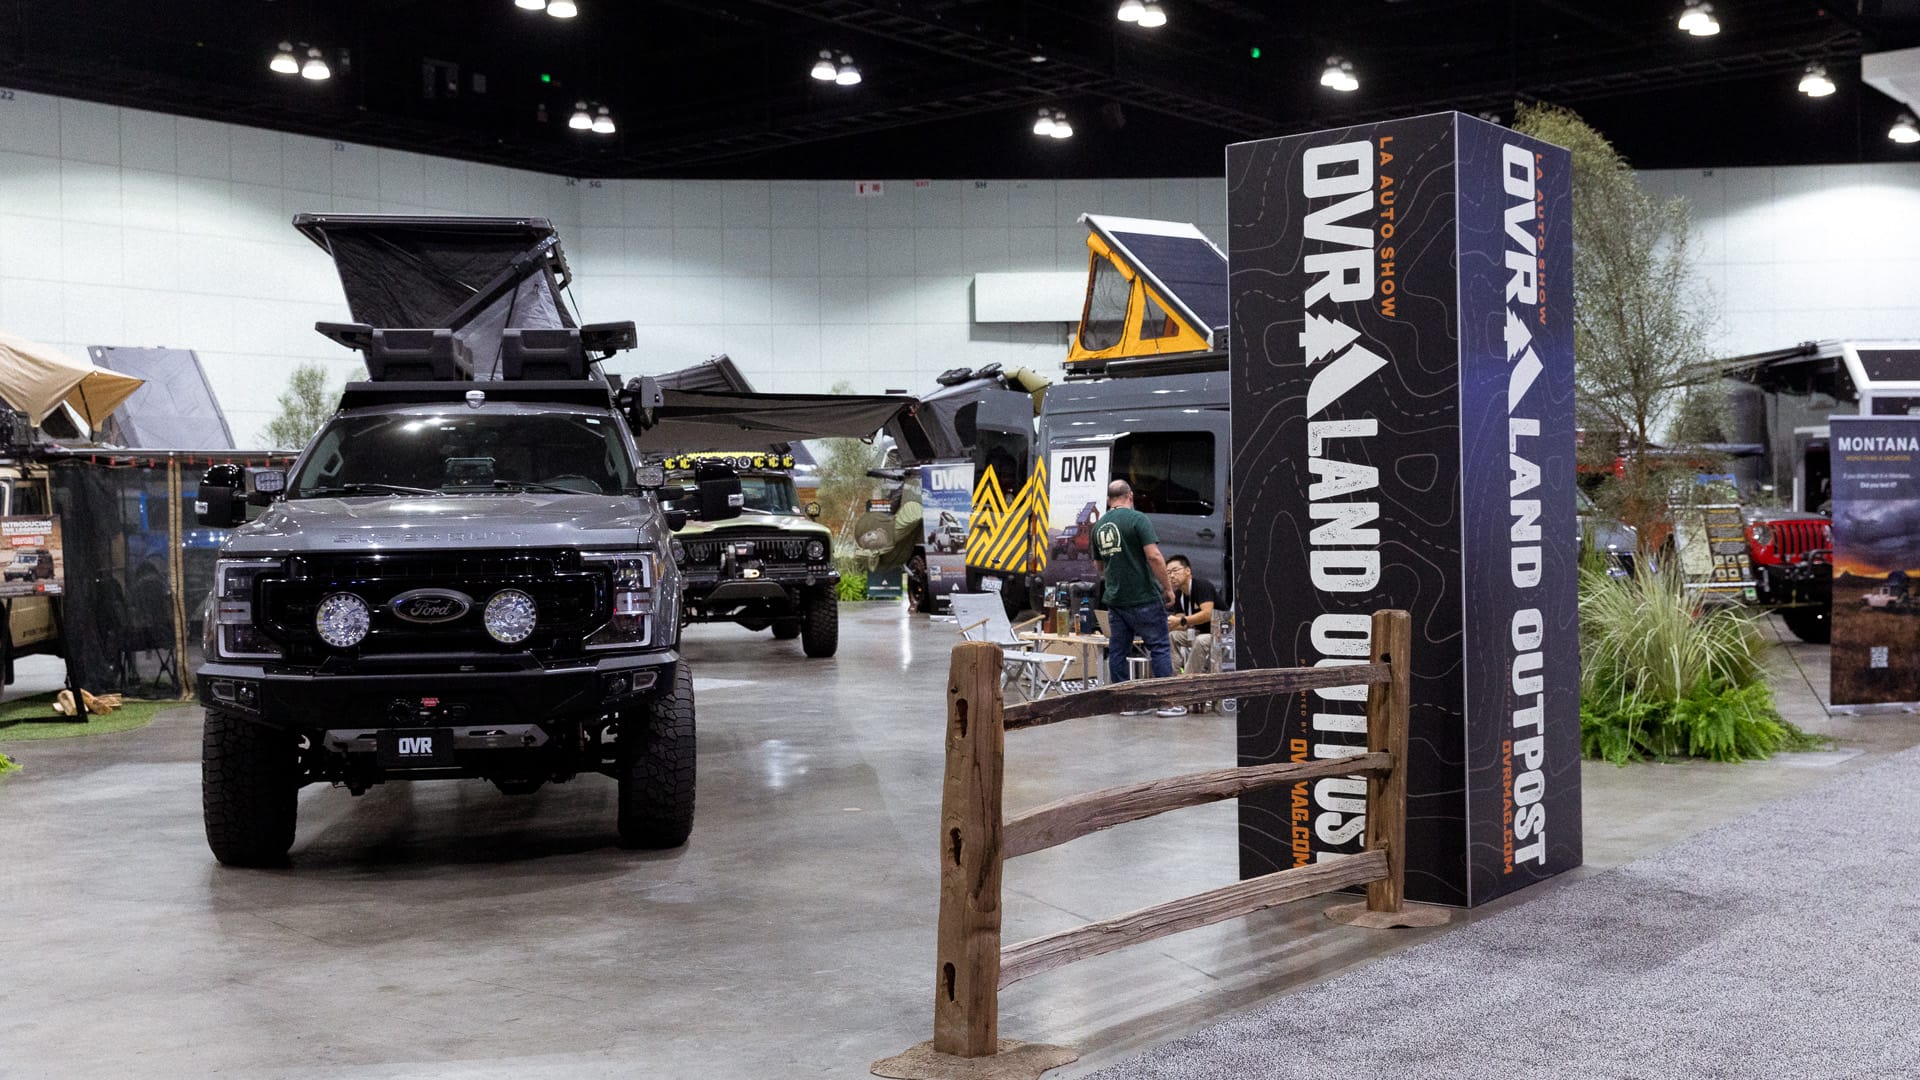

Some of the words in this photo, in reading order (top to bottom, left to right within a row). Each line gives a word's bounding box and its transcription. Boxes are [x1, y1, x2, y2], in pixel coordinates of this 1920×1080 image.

[1380, 136, 1394, 166] LA
[1536, 153, 1544, 180] LA
[1303, 140, 1375, 309] OVR
[1380, 175, 1395, 240] AUTO
[1503, 143, 1538, 305] OVR
[1537, 189, 1545, 251] AUTO
[1380, 246, 1396, 318] SHOW
[1538, 258, 1547, 326] SHOW
[1061, 456, 1096, 483] OVR
[1838, 436, 1920, 452] MONTANA
[1307, 418, 1381, 592] LAND
[1508, 417, 1542, 588] LAND
[410, 600, 453, 616] Ford
[398, 737, 433, 754] OVR
[1511, 608, 1546, 866] OUTPOST
[1502, 739, 1514, 875] OVRMAG.COM
